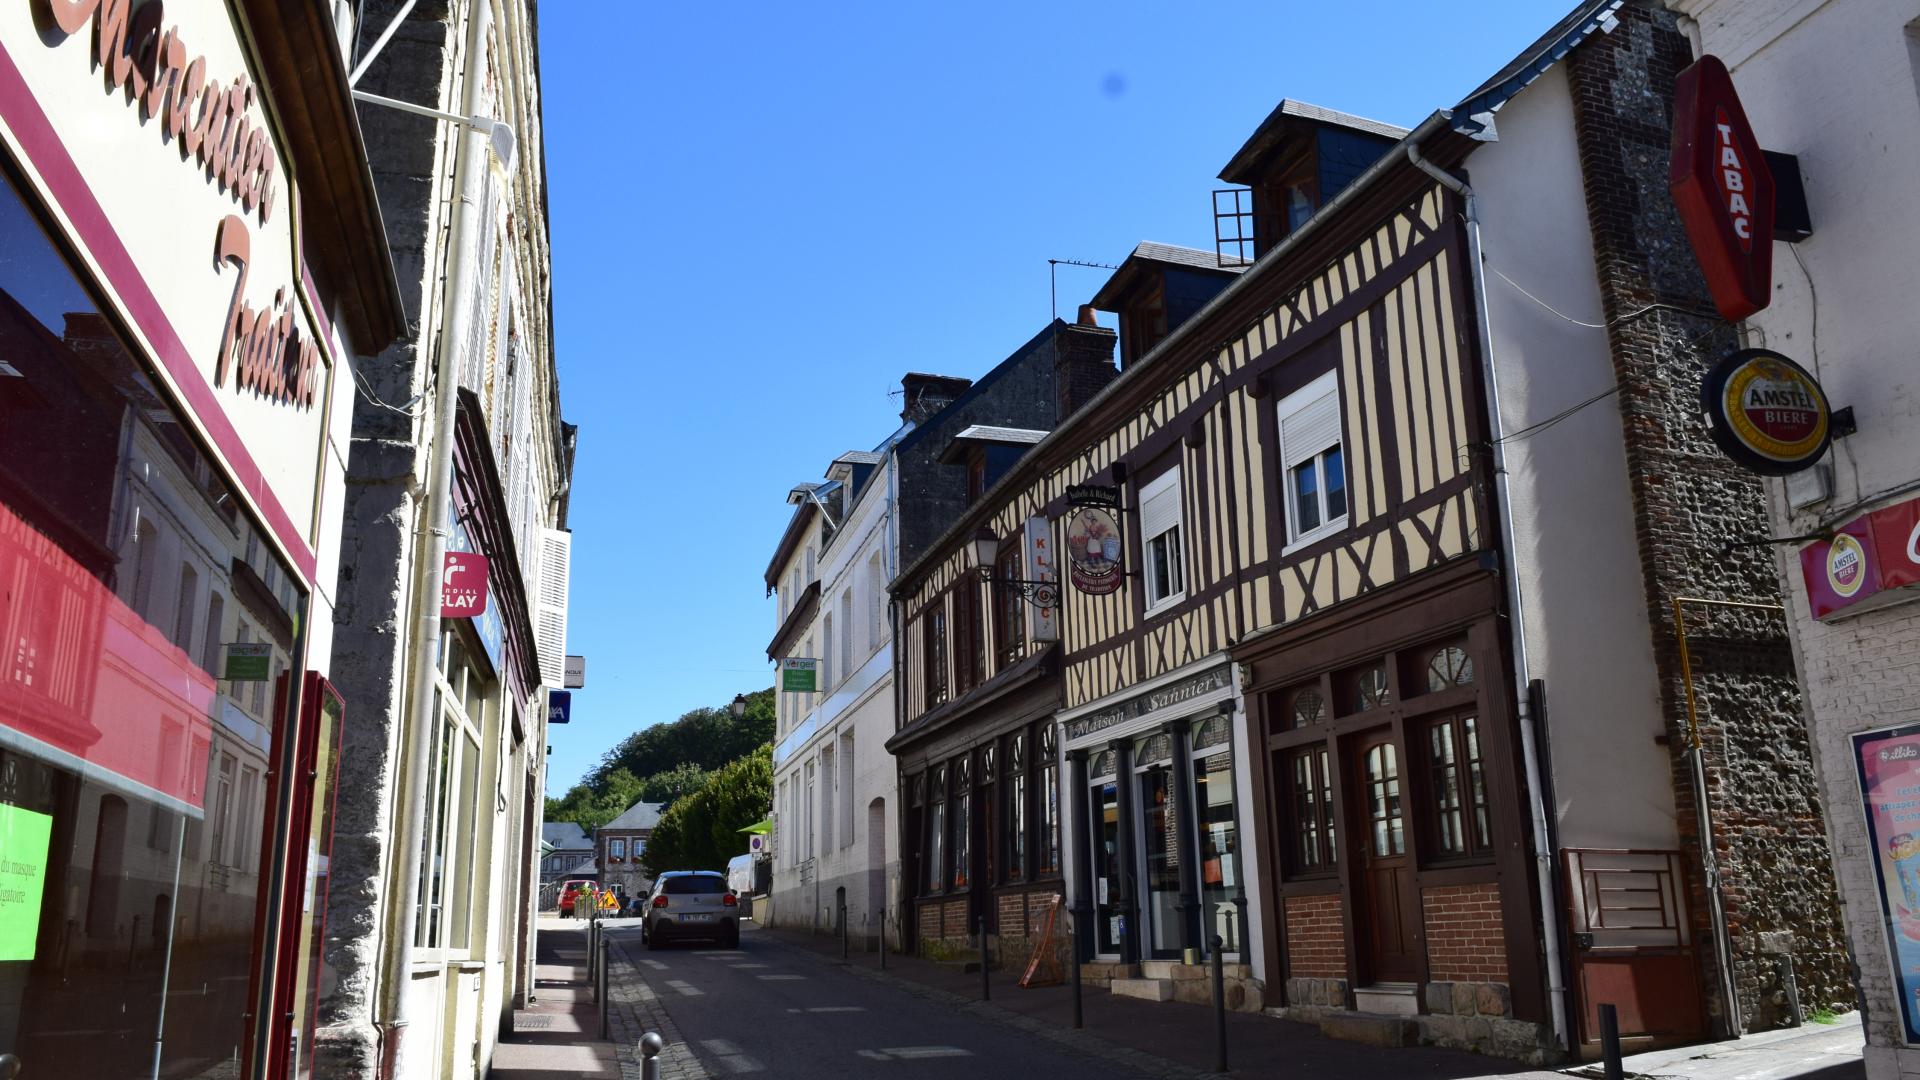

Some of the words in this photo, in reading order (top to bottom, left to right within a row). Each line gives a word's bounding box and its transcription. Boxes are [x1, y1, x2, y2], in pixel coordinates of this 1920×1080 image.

[1717, 123, 1750, 239] TABAC
[1750, 389, 1814, 409] AMSTEL
[1765, 411, 1808, 425] BIERE
[1834, 552, 1857, 570] AMSTEL
[1839, 565, 1855, 579] BIERE
[441, 595, 477, 608] ELAY
[785, 659, 815, 669] Verger
[549, 705, 565, 719] XA
[1074, 711, 1125, 738] Maison
[1149, 677, 1214, 712] Sannier
[1, 856, 10, 873] du
[12, 862, 36, 880] masque
